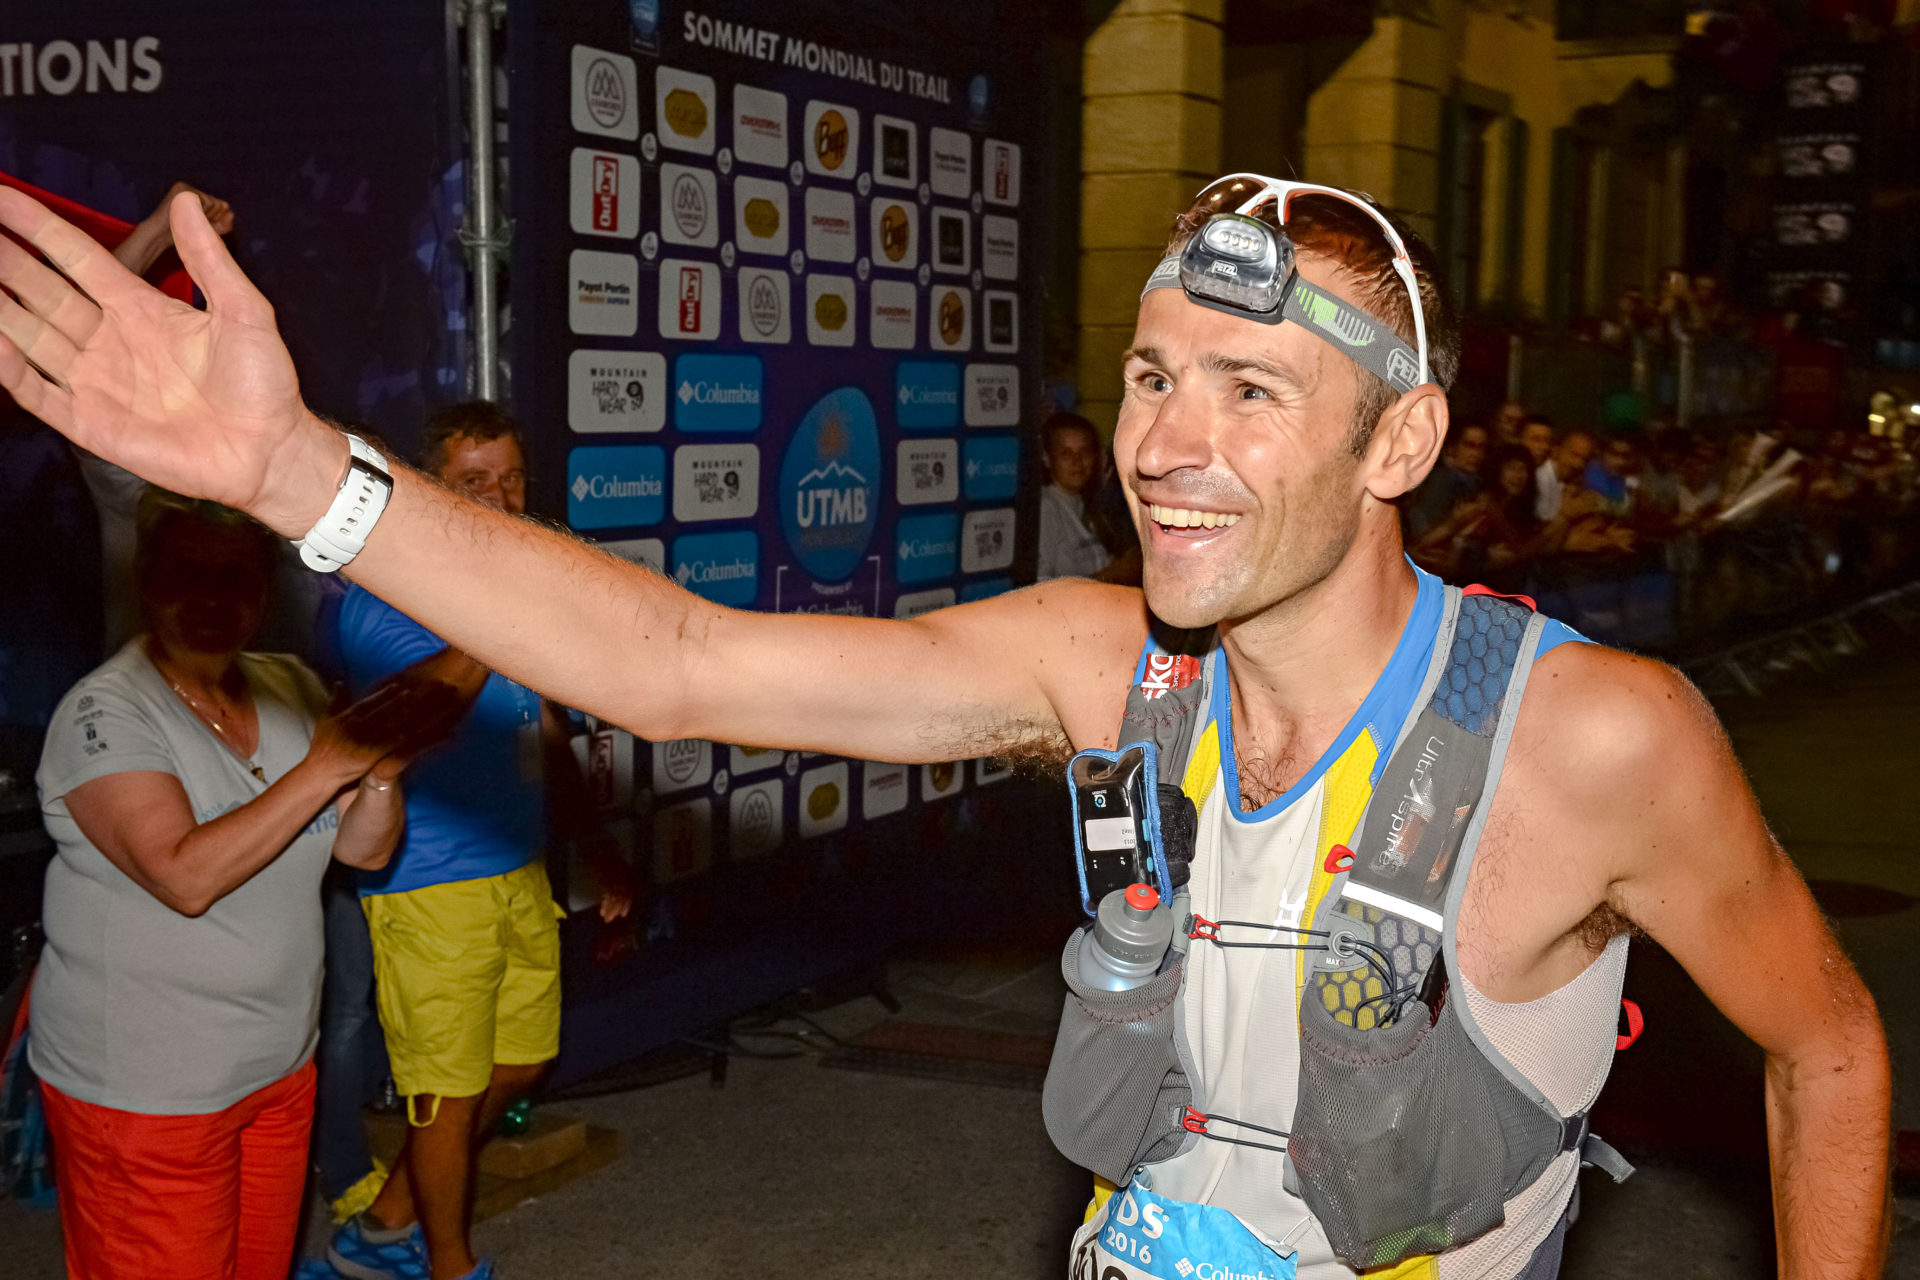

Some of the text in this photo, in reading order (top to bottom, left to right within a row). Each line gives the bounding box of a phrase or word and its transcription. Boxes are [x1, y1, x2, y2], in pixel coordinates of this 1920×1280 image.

[0, 36, 162, 96] TIONS
[683, 10, 951, 104] SOMMET MONDIAL DU TRAIL
[1212, 261, 1237, 276] PETZL
[590, 367, 647, 378] MOUNTAIN
[592, 381, 620, 398] HARD
[694, 380, 760, 404] Columbia
[599, 397, 626, 414] WEAR
[692, 460, 743, 470] MOUNTAIN
[589, 474, 663, 499] Columbia
[796, 486, 868, 528] UTMB
[690, 558, 756, 584] Columbia
[1325, 958, 1340, 966] MAX
[1112, 1190, 1165, 1240] DS
[1105, 1225, 1152, 1265] 2016
